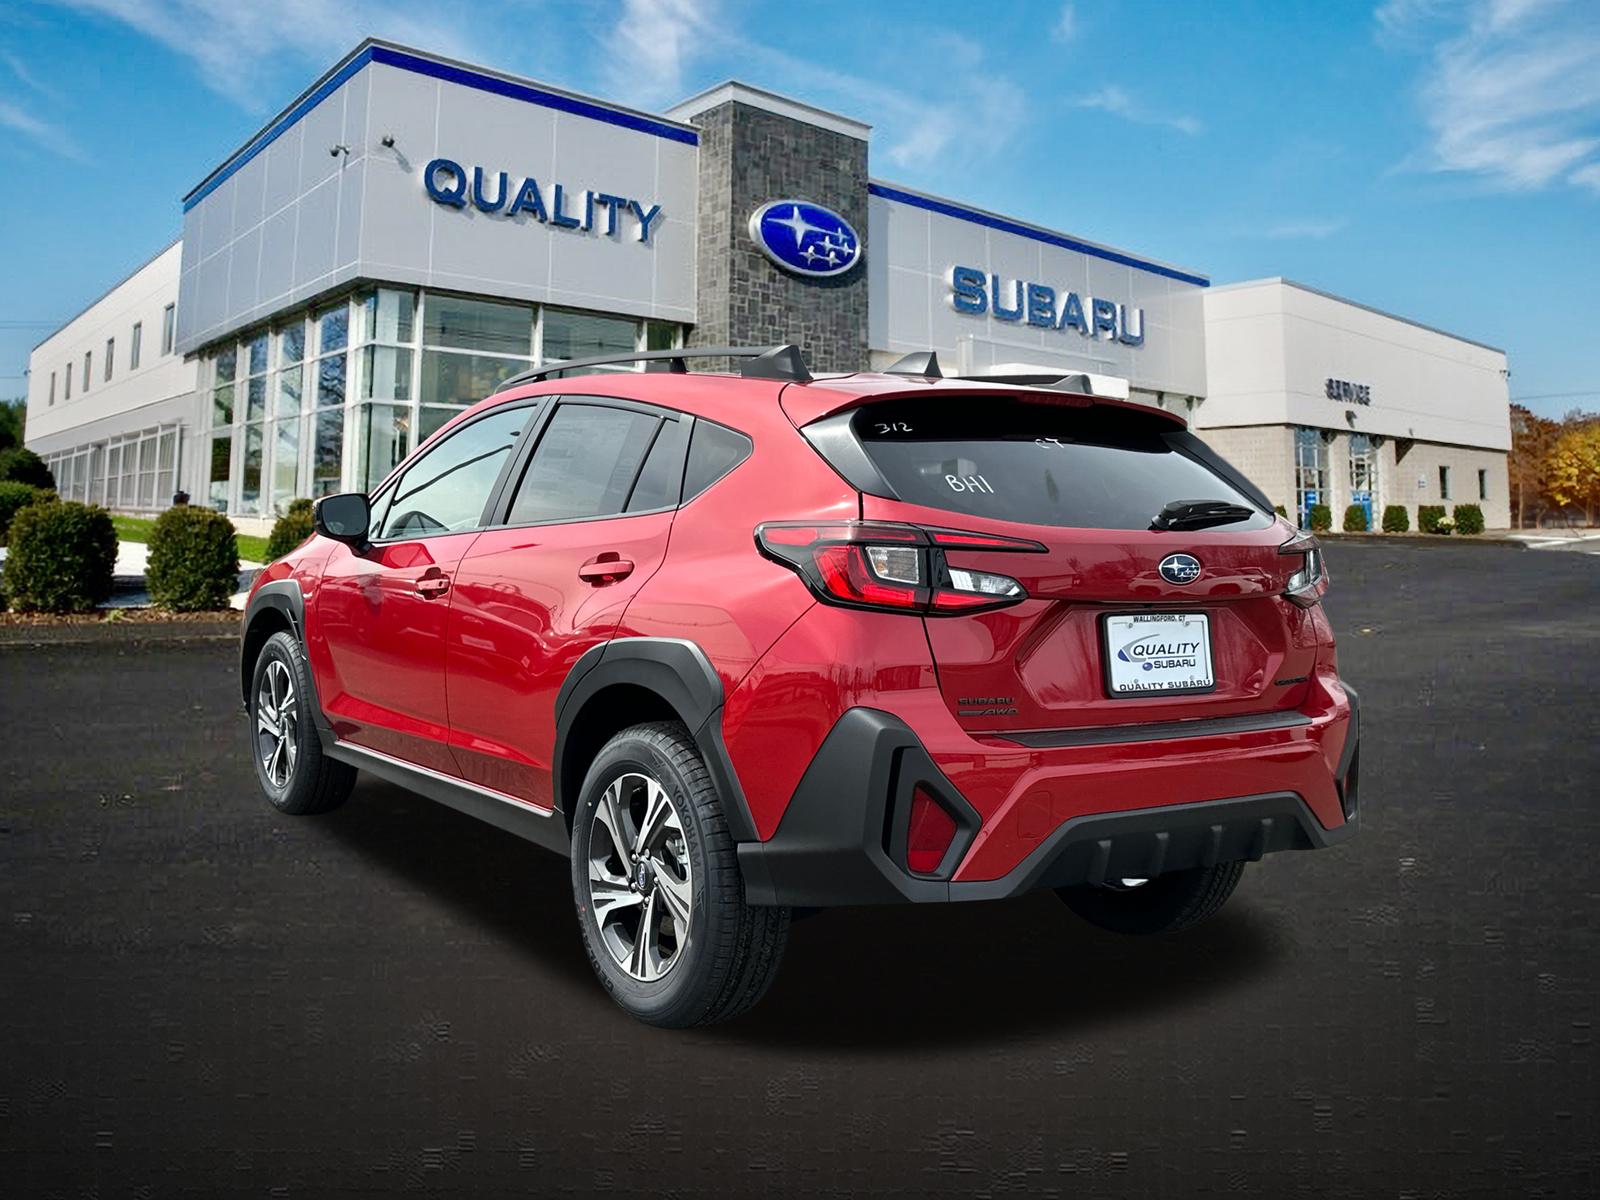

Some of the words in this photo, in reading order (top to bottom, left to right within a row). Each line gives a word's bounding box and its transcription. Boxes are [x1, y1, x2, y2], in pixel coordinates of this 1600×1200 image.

[423, 158, 663, 243] QUALITY
[950, 264, 1145, 347] SUBARU
[874, 422, 913, 434] 312
[1133, 642, 1200, 656] QUALITY
[1153, 659, 1196, 669] SUBARU
[1119, 682, 1164, 692] QUALITY
[1167, 679, 1211, 689] SUBARU
[957, 696, 1015, 706] SUBARU
